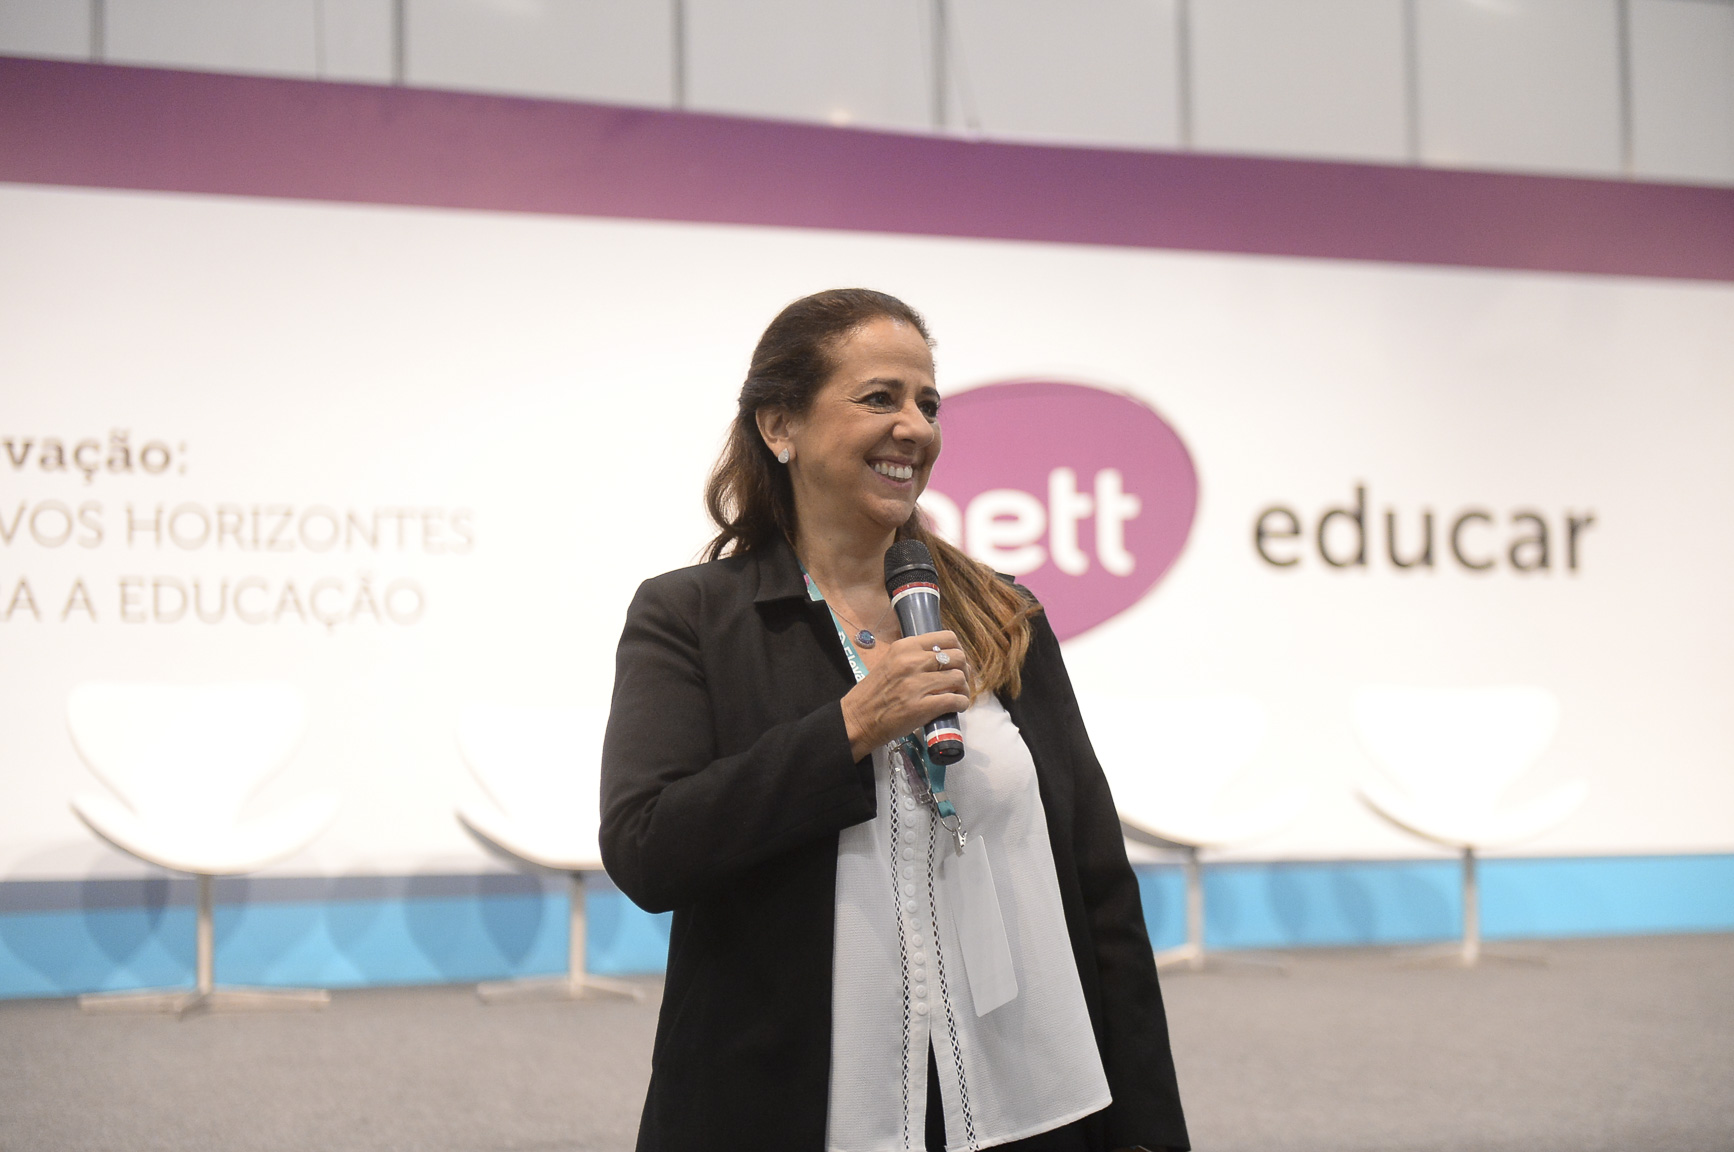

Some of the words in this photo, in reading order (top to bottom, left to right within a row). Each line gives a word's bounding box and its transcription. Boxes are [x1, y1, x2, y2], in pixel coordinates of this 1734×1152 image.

[124, 502, 476, 555] HORIZONTES
[1253, 482, 1597, 574] educar
[61, 576, 98, 623] A
[118, 570, 426, 633] EDUCAÇÃO
